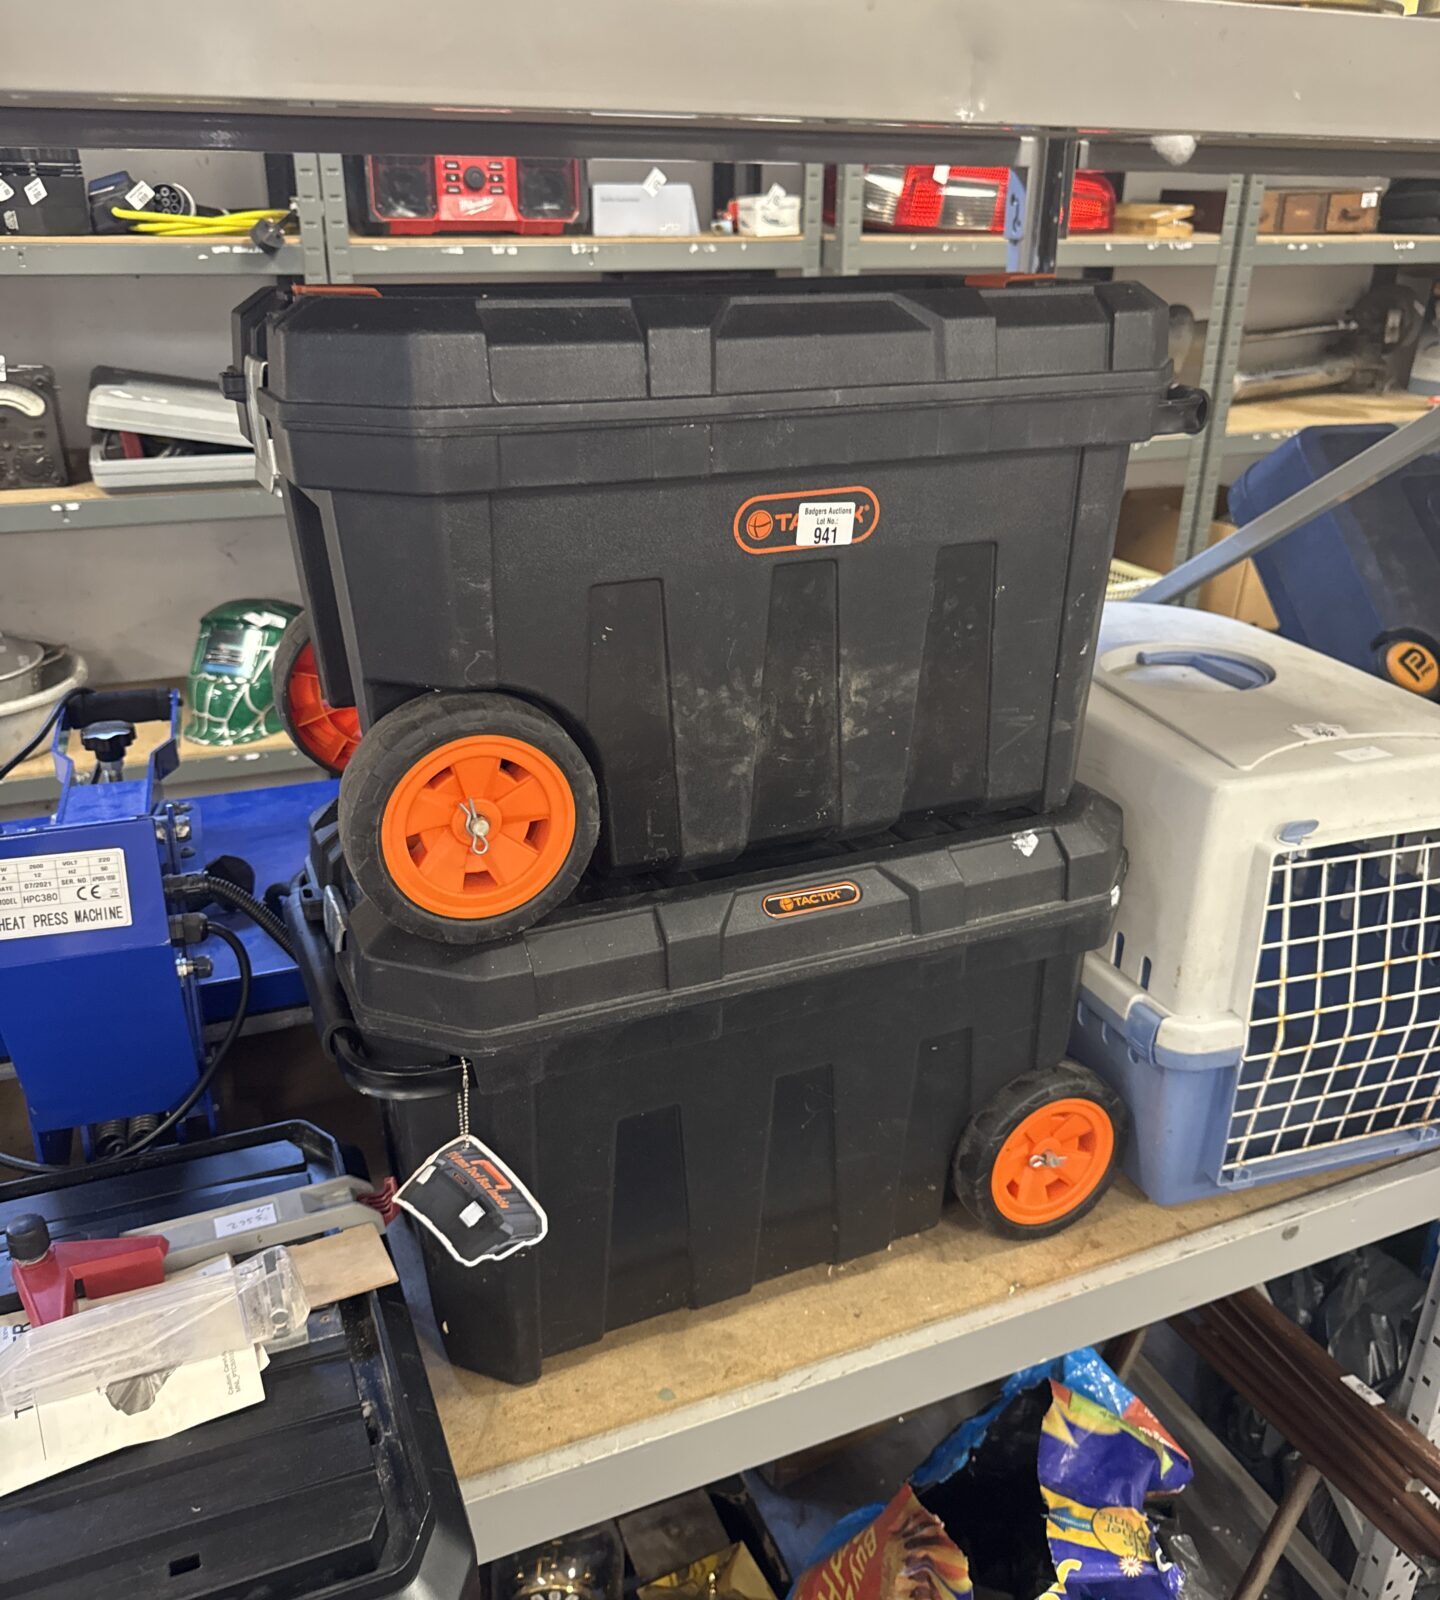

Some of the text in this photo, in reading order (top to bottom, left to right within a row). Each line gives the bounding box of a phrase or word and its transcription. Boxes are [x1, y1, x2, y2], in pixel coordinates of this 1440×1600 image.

[805, 507, 852, 516] Badgers Auctions
[814, 527, 837, 544] 941
[24, 881, 52, 889] 07/2021
[23, 893, 58, 904] HPC380
[793, 891, 841, 906] TACTIX
[33, 912, 69, 928] PRESS
[74, 906, 124, 923] MACHINE
